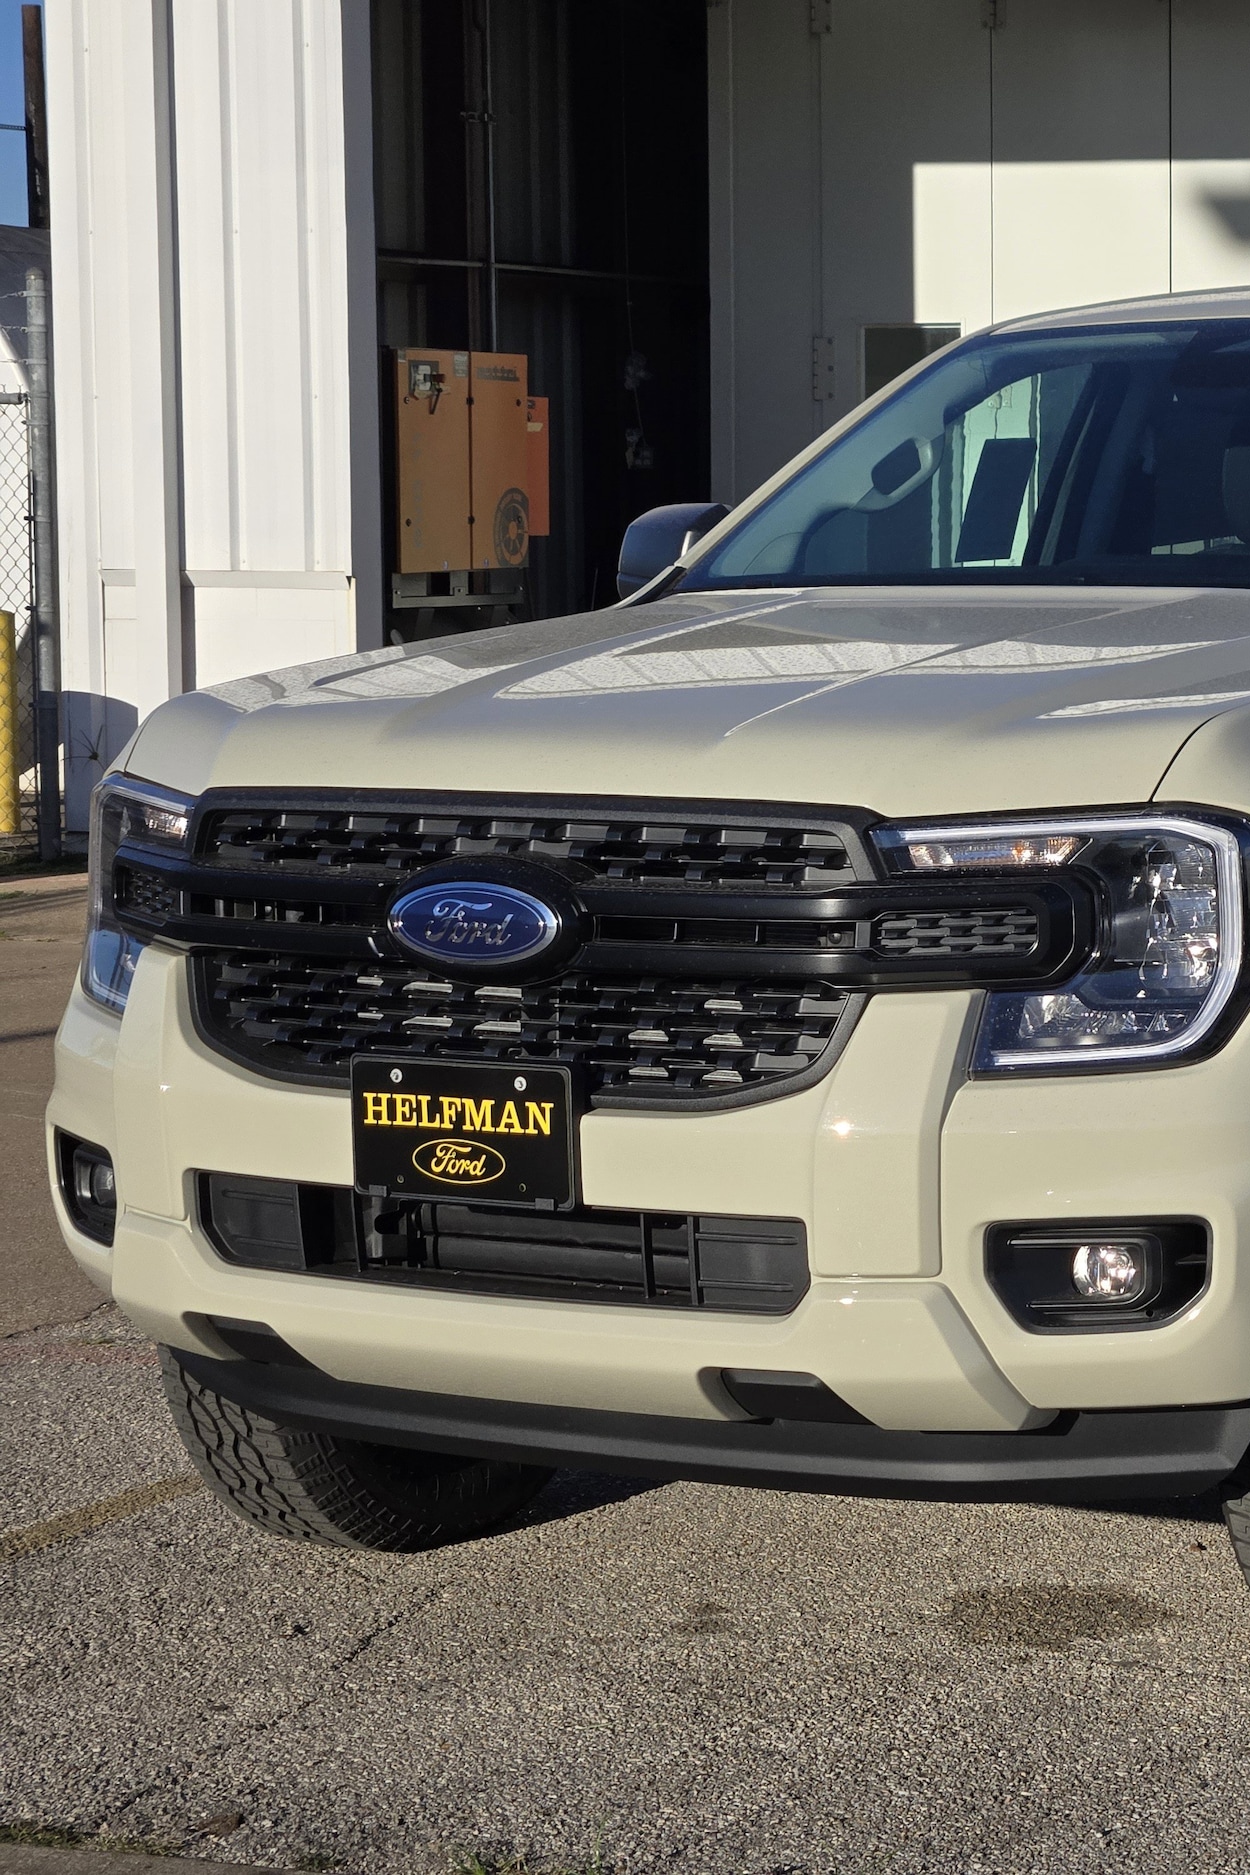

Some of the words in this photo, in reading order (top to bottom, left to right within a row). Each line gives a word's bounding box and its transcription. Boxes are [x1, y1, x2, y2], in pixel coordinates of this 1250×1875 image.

[425, 899, 514, 945] Ford
[362, 1092, 555, 1136] HELFMAN
[430, 1143, 487, 1177] Ford
